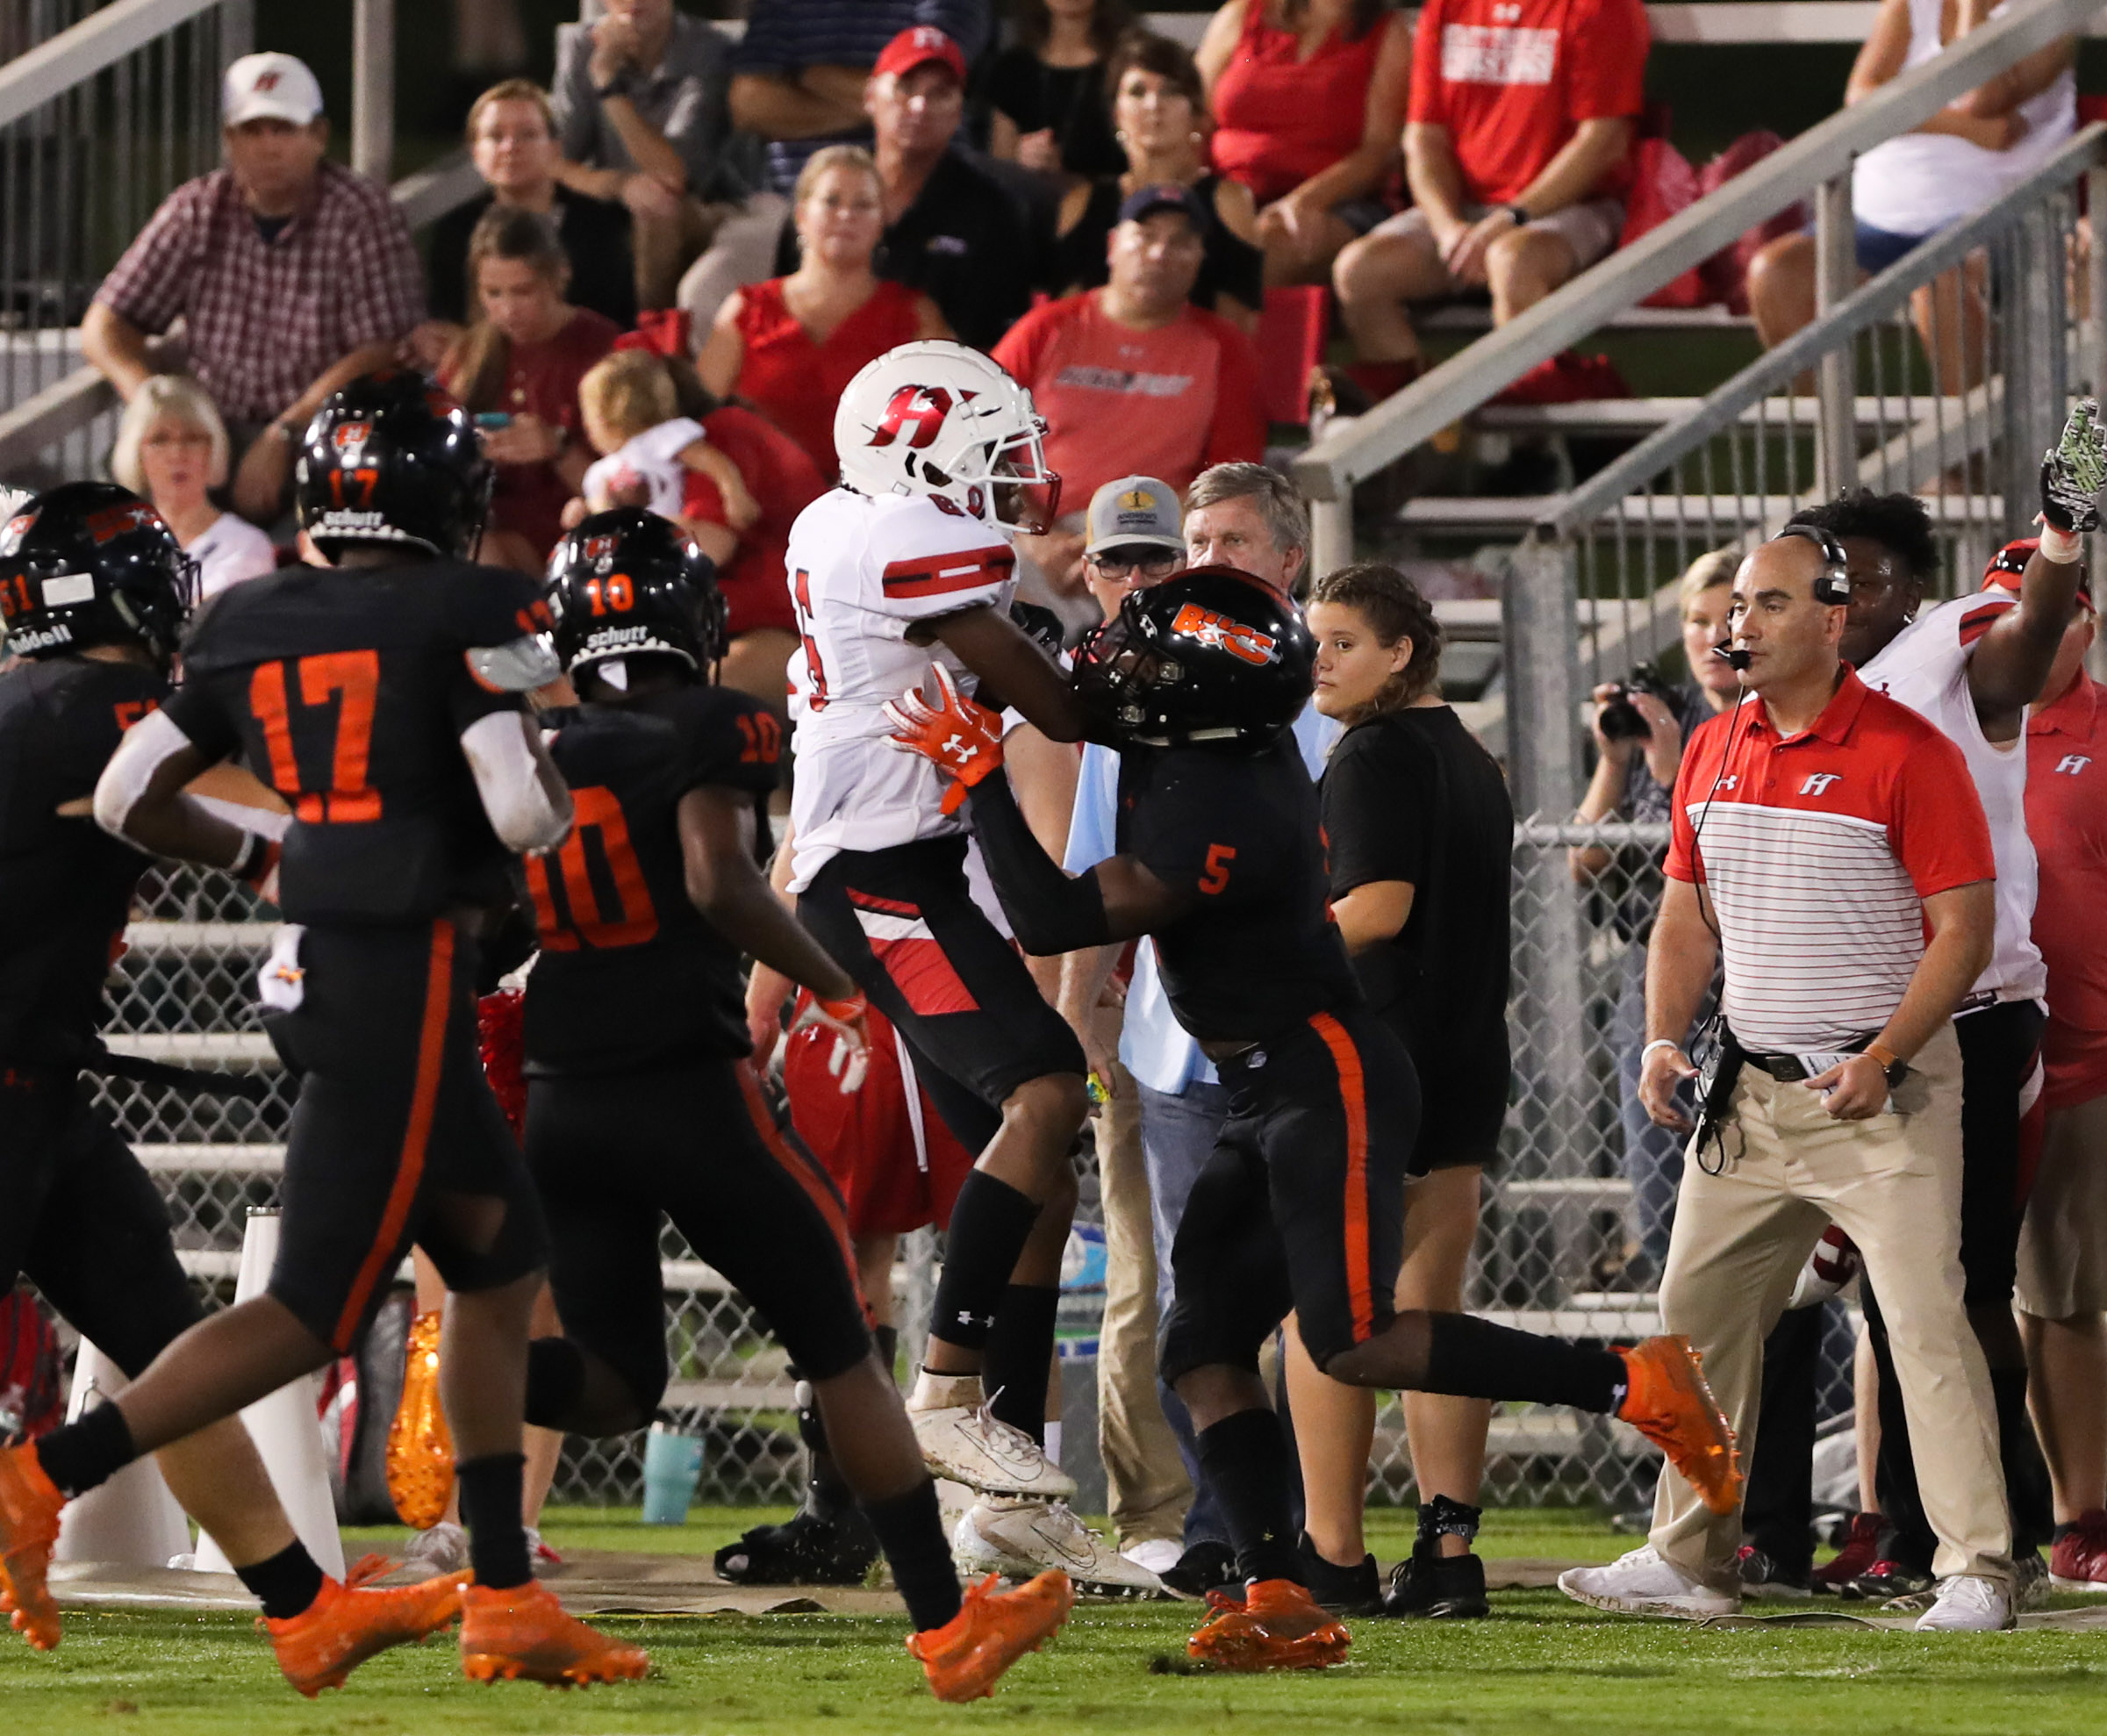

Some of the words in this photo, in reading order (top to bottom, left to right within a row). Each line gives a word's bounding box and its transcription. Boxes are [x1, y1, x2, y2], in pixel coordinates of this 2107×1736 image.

[328, 468, 379, 509] 17
[586, 573, 634, 617] 10
[586, 625, 648, 649] schutt
[249, 648, 383, 824] 17
[736, 712, 782, 764] 10
[523, 786, 659, 952] 10
[1198, 842, 1236, 895] 5
